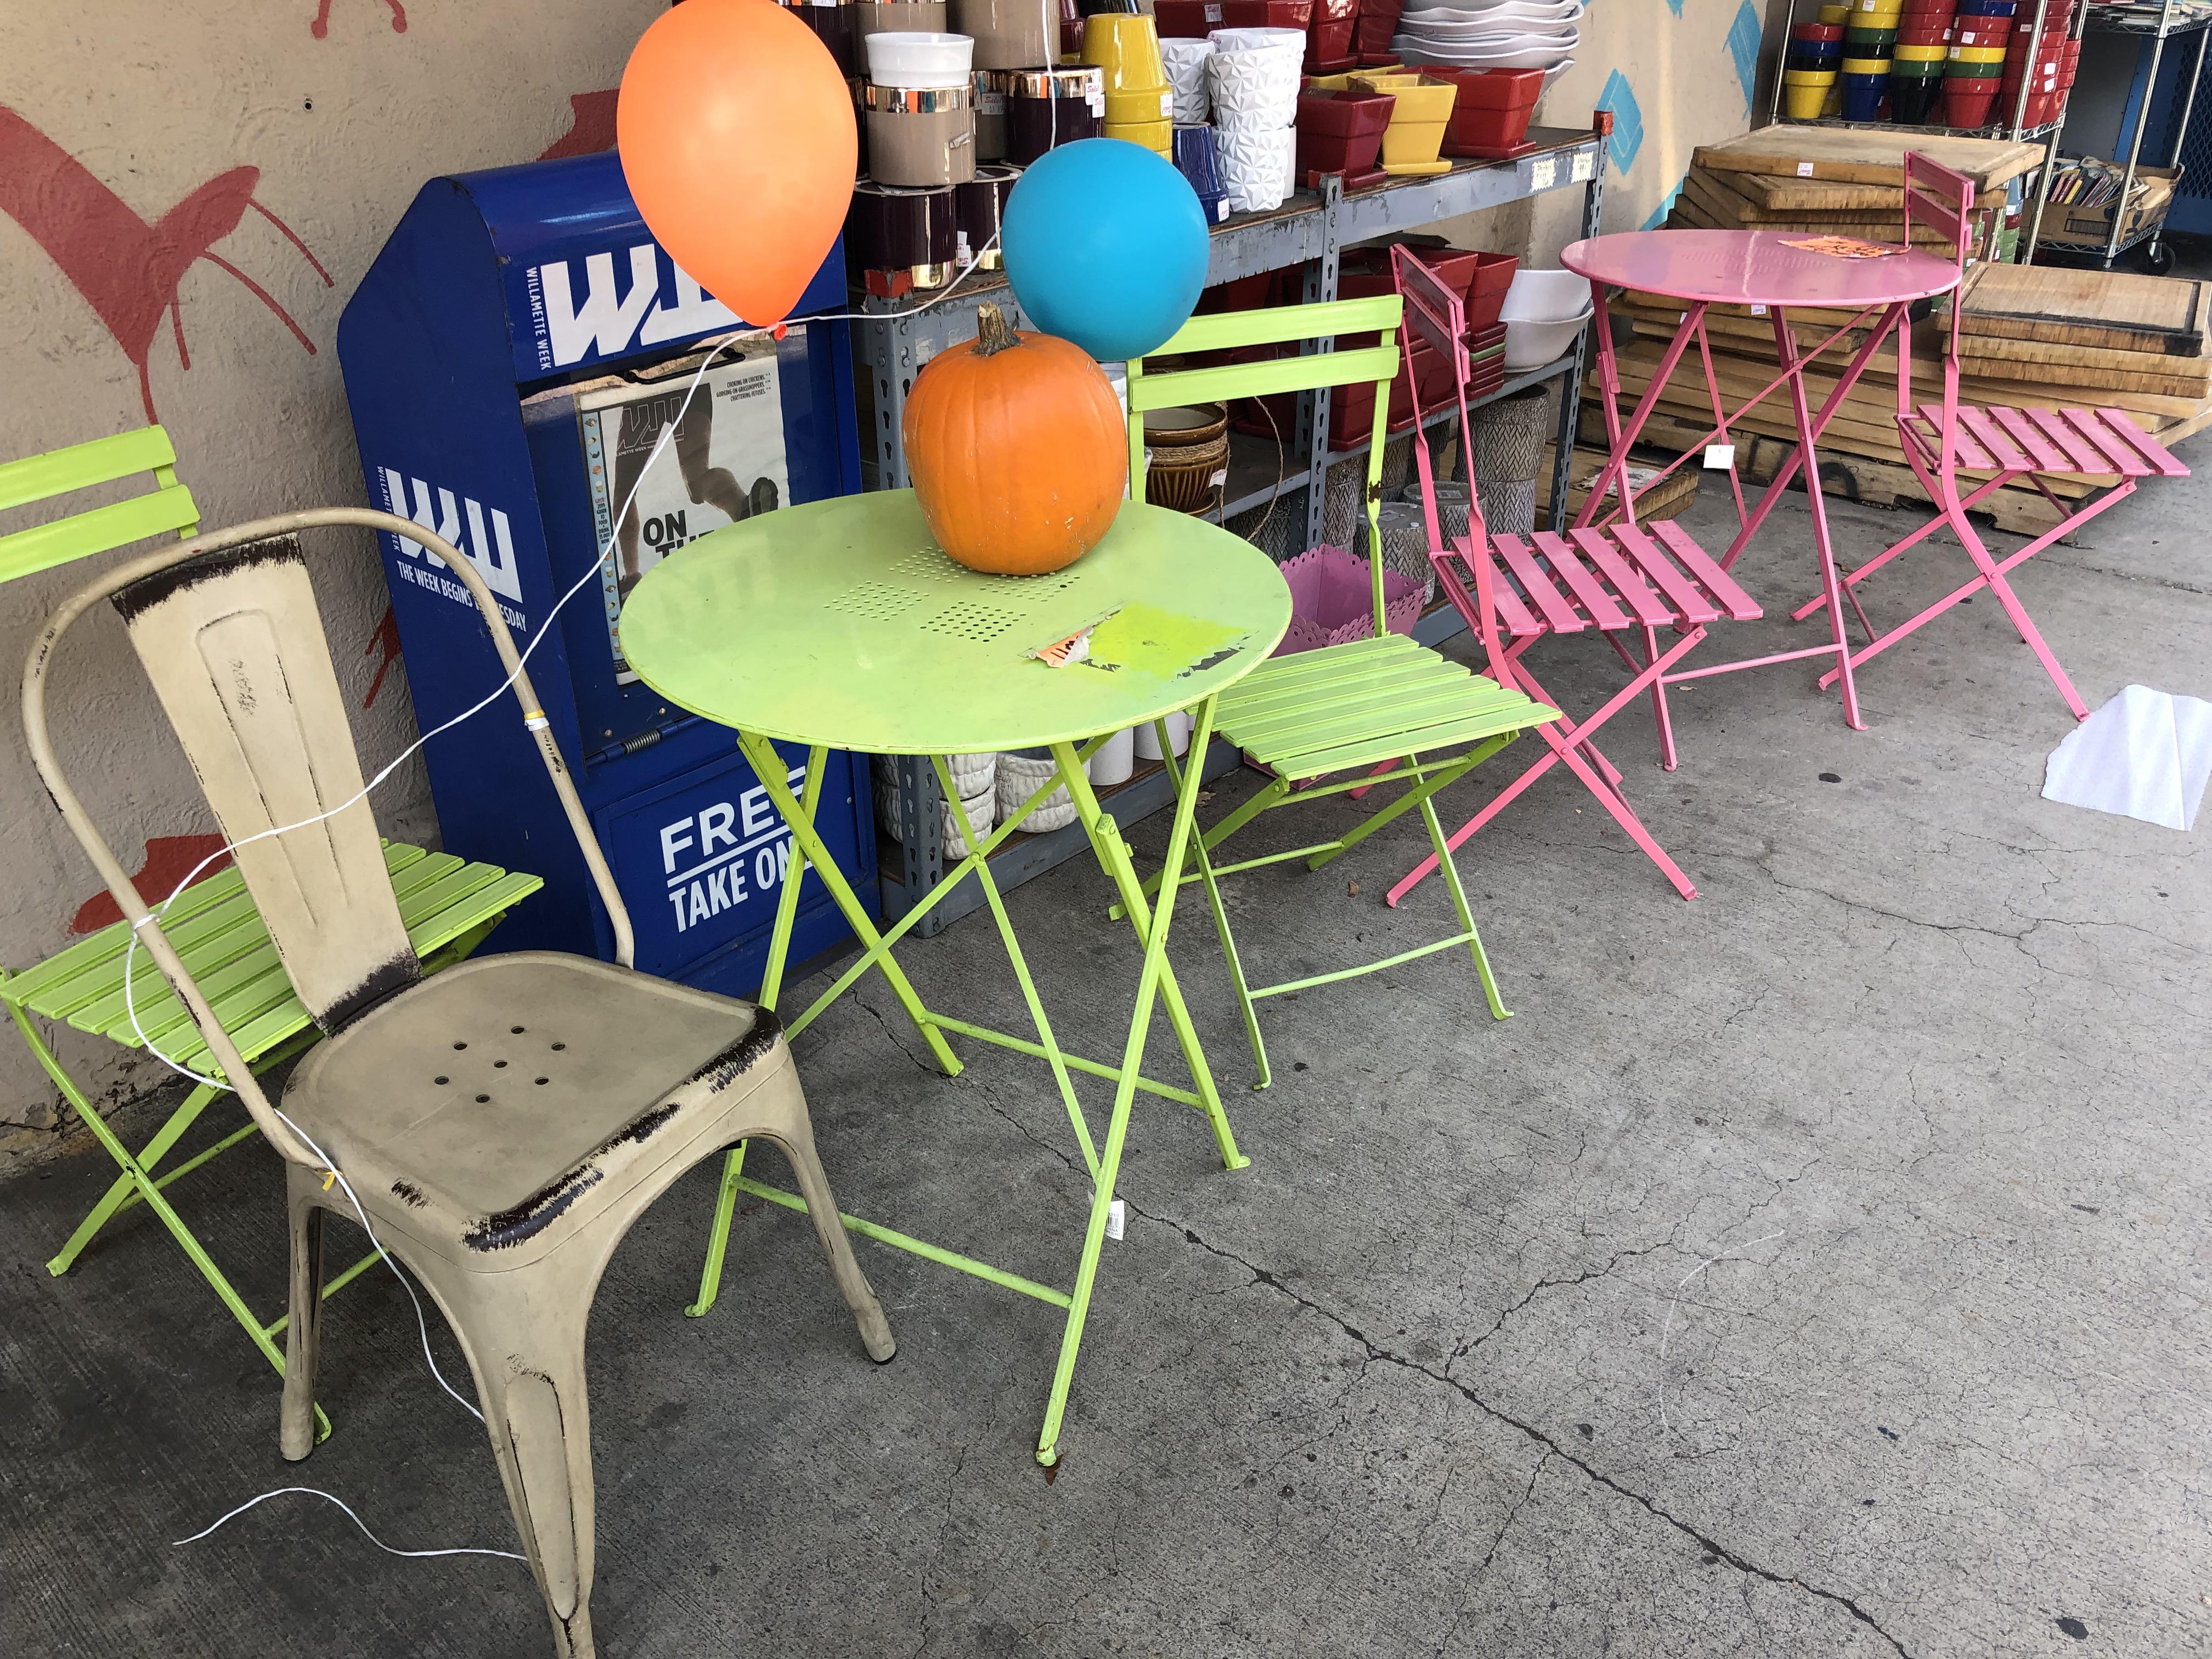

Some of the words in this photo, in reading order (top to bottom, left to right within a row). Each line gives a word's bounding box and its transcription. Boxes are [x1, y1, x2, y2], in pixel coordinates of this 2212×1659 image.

[526, 267, 546, 337] WILLAMETTE
[537, 338, 552, 371] WEEK
[377, 466, 392, 514] WILLAMET
[643, 510, 687, 546] ON
[397, 560, 415, 583] THE
[414, 567, 441, 594] WEEK
[440, 577, 473, 607] BEGINS
[669, 859, 748, 933] TAKE
[755, 835, 813, 890] ON
